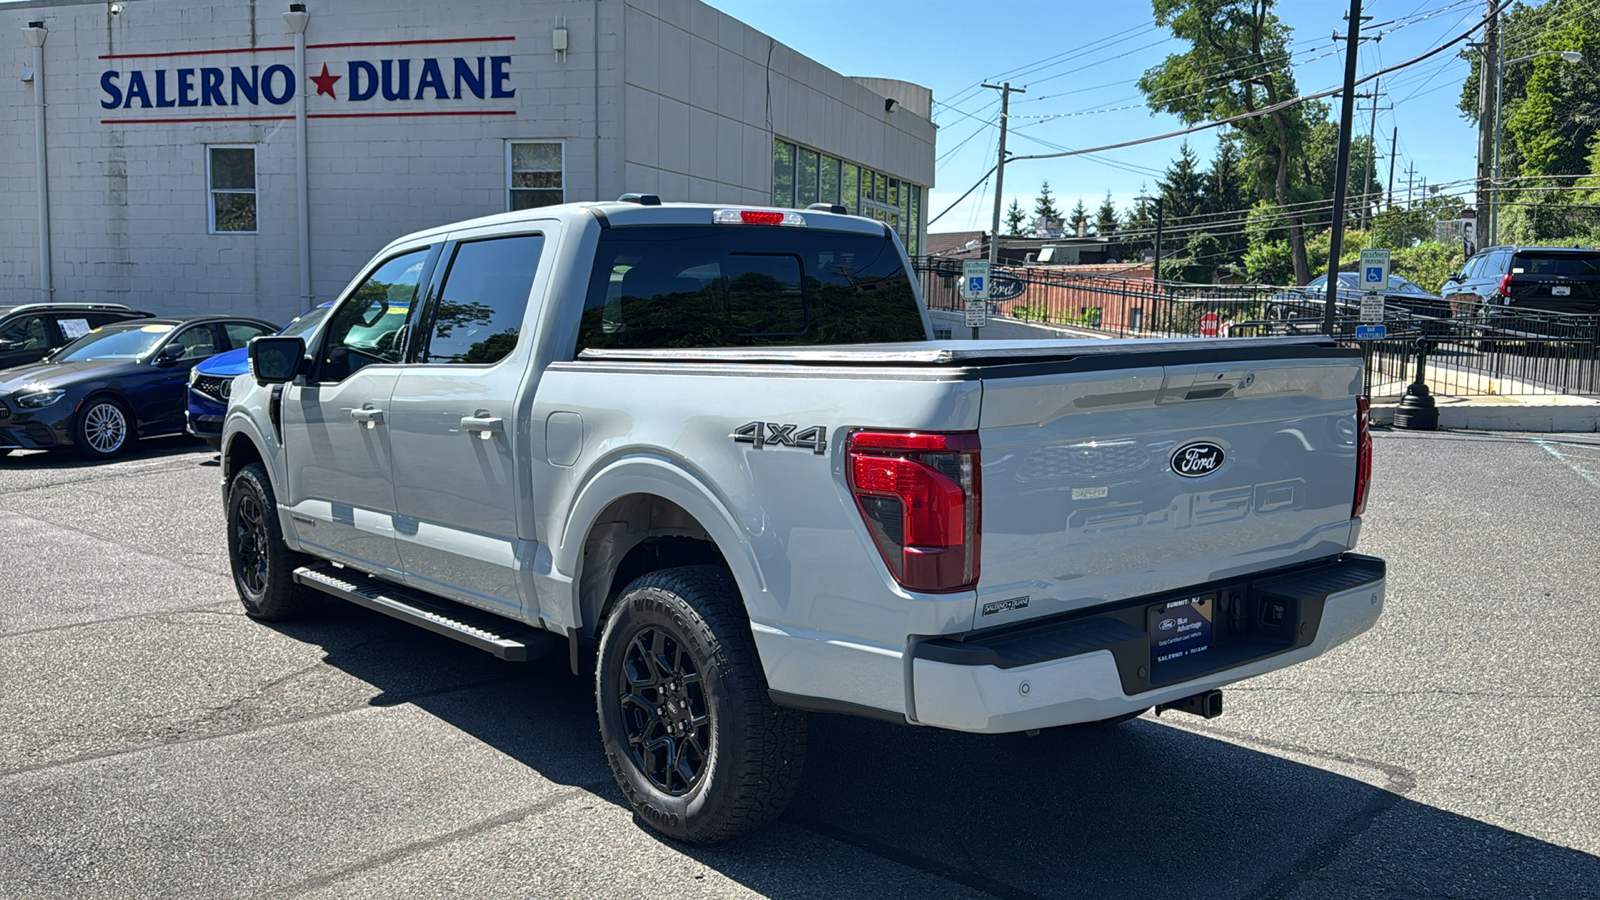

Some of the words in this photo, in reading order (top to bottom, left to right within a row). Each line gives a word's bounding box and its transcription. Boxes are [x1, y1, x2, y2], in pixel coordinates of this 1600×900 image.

[100, 64, 296, 109] SALERNO
[347, 56, 517, 101] DUANE
[1201, 320, 1218, 330] STOP
[1181, 448, 1218, 472] Ford
[1177, 621, 1202, 632] Advantage
